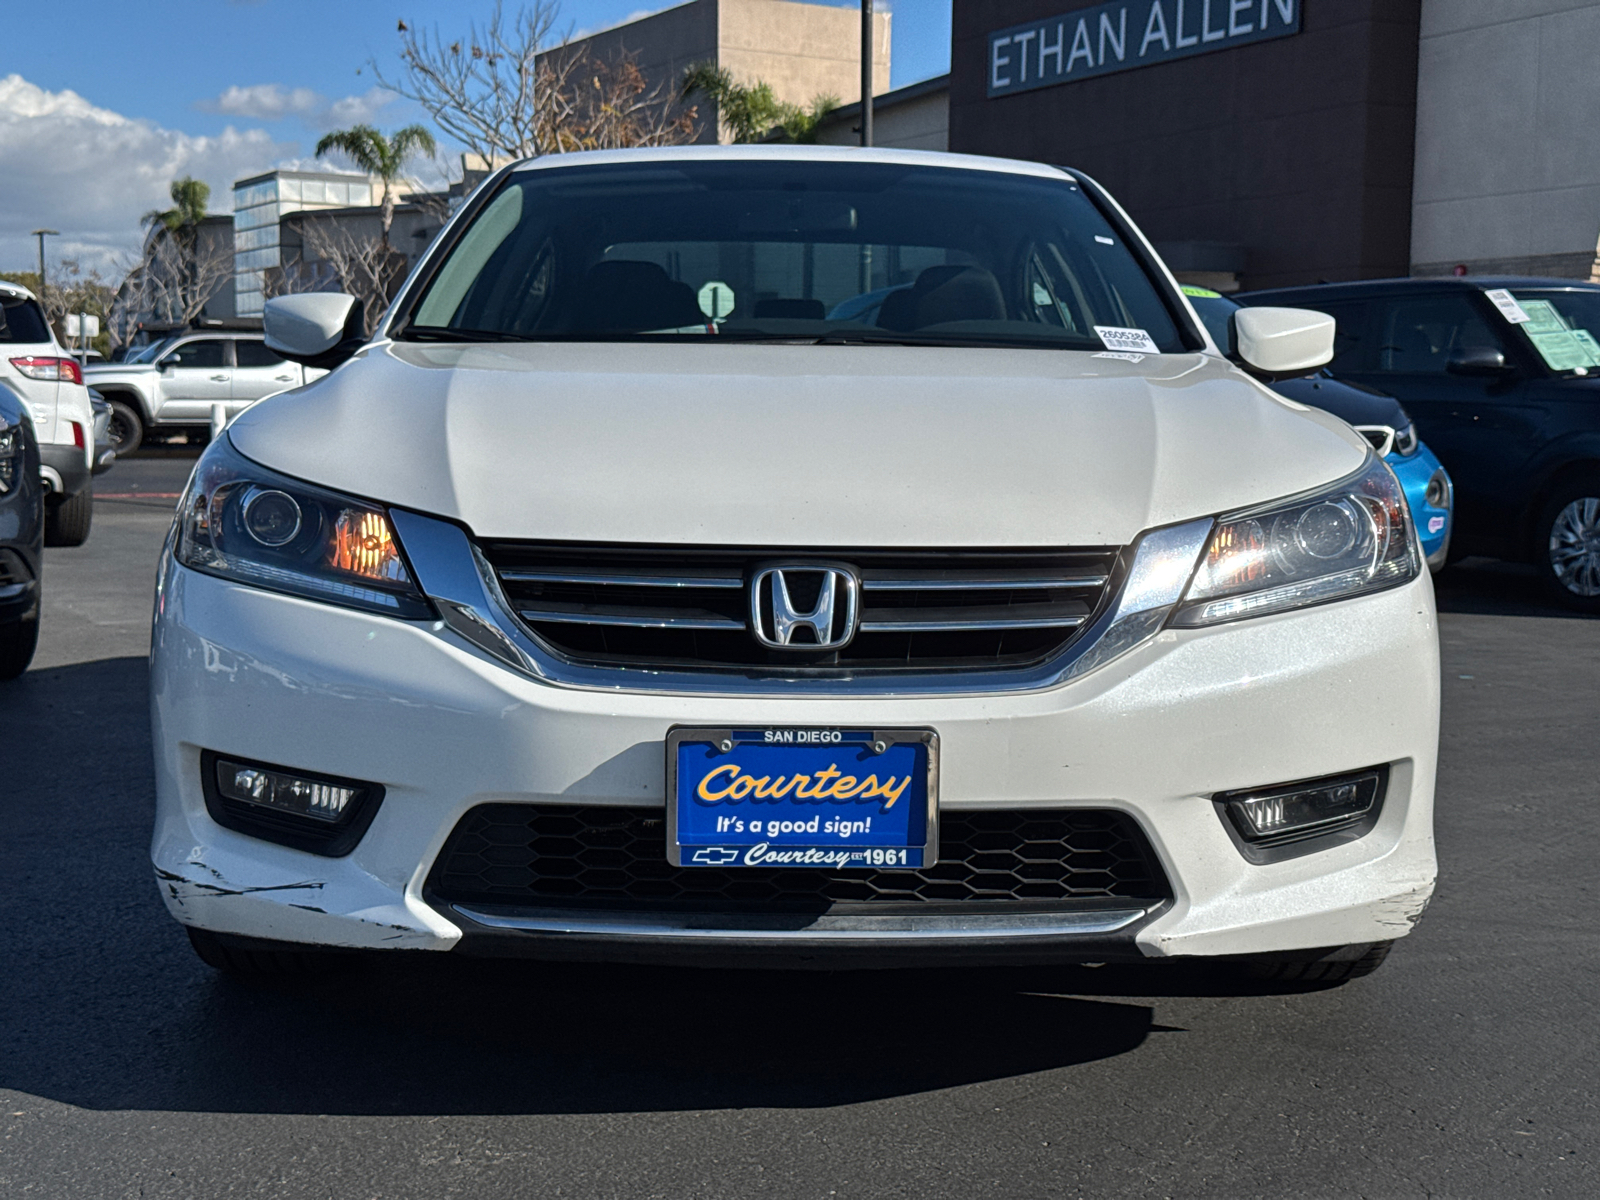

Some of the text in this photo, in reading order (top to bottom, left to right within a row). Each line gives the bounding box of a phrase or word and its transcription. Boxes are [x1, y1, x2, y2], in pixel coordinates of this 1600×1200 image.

[992, 0, 1293, 88] ETHAN ALLEN
[764, 730, 842, 742] SAN DIEGO
[697, 763, 911, 808] Courtesy
[716, 815, 871, 837] It's a good sign!
[743, 842, 850, 870] Courtesy
[863, 849, 907, 865] 1961
